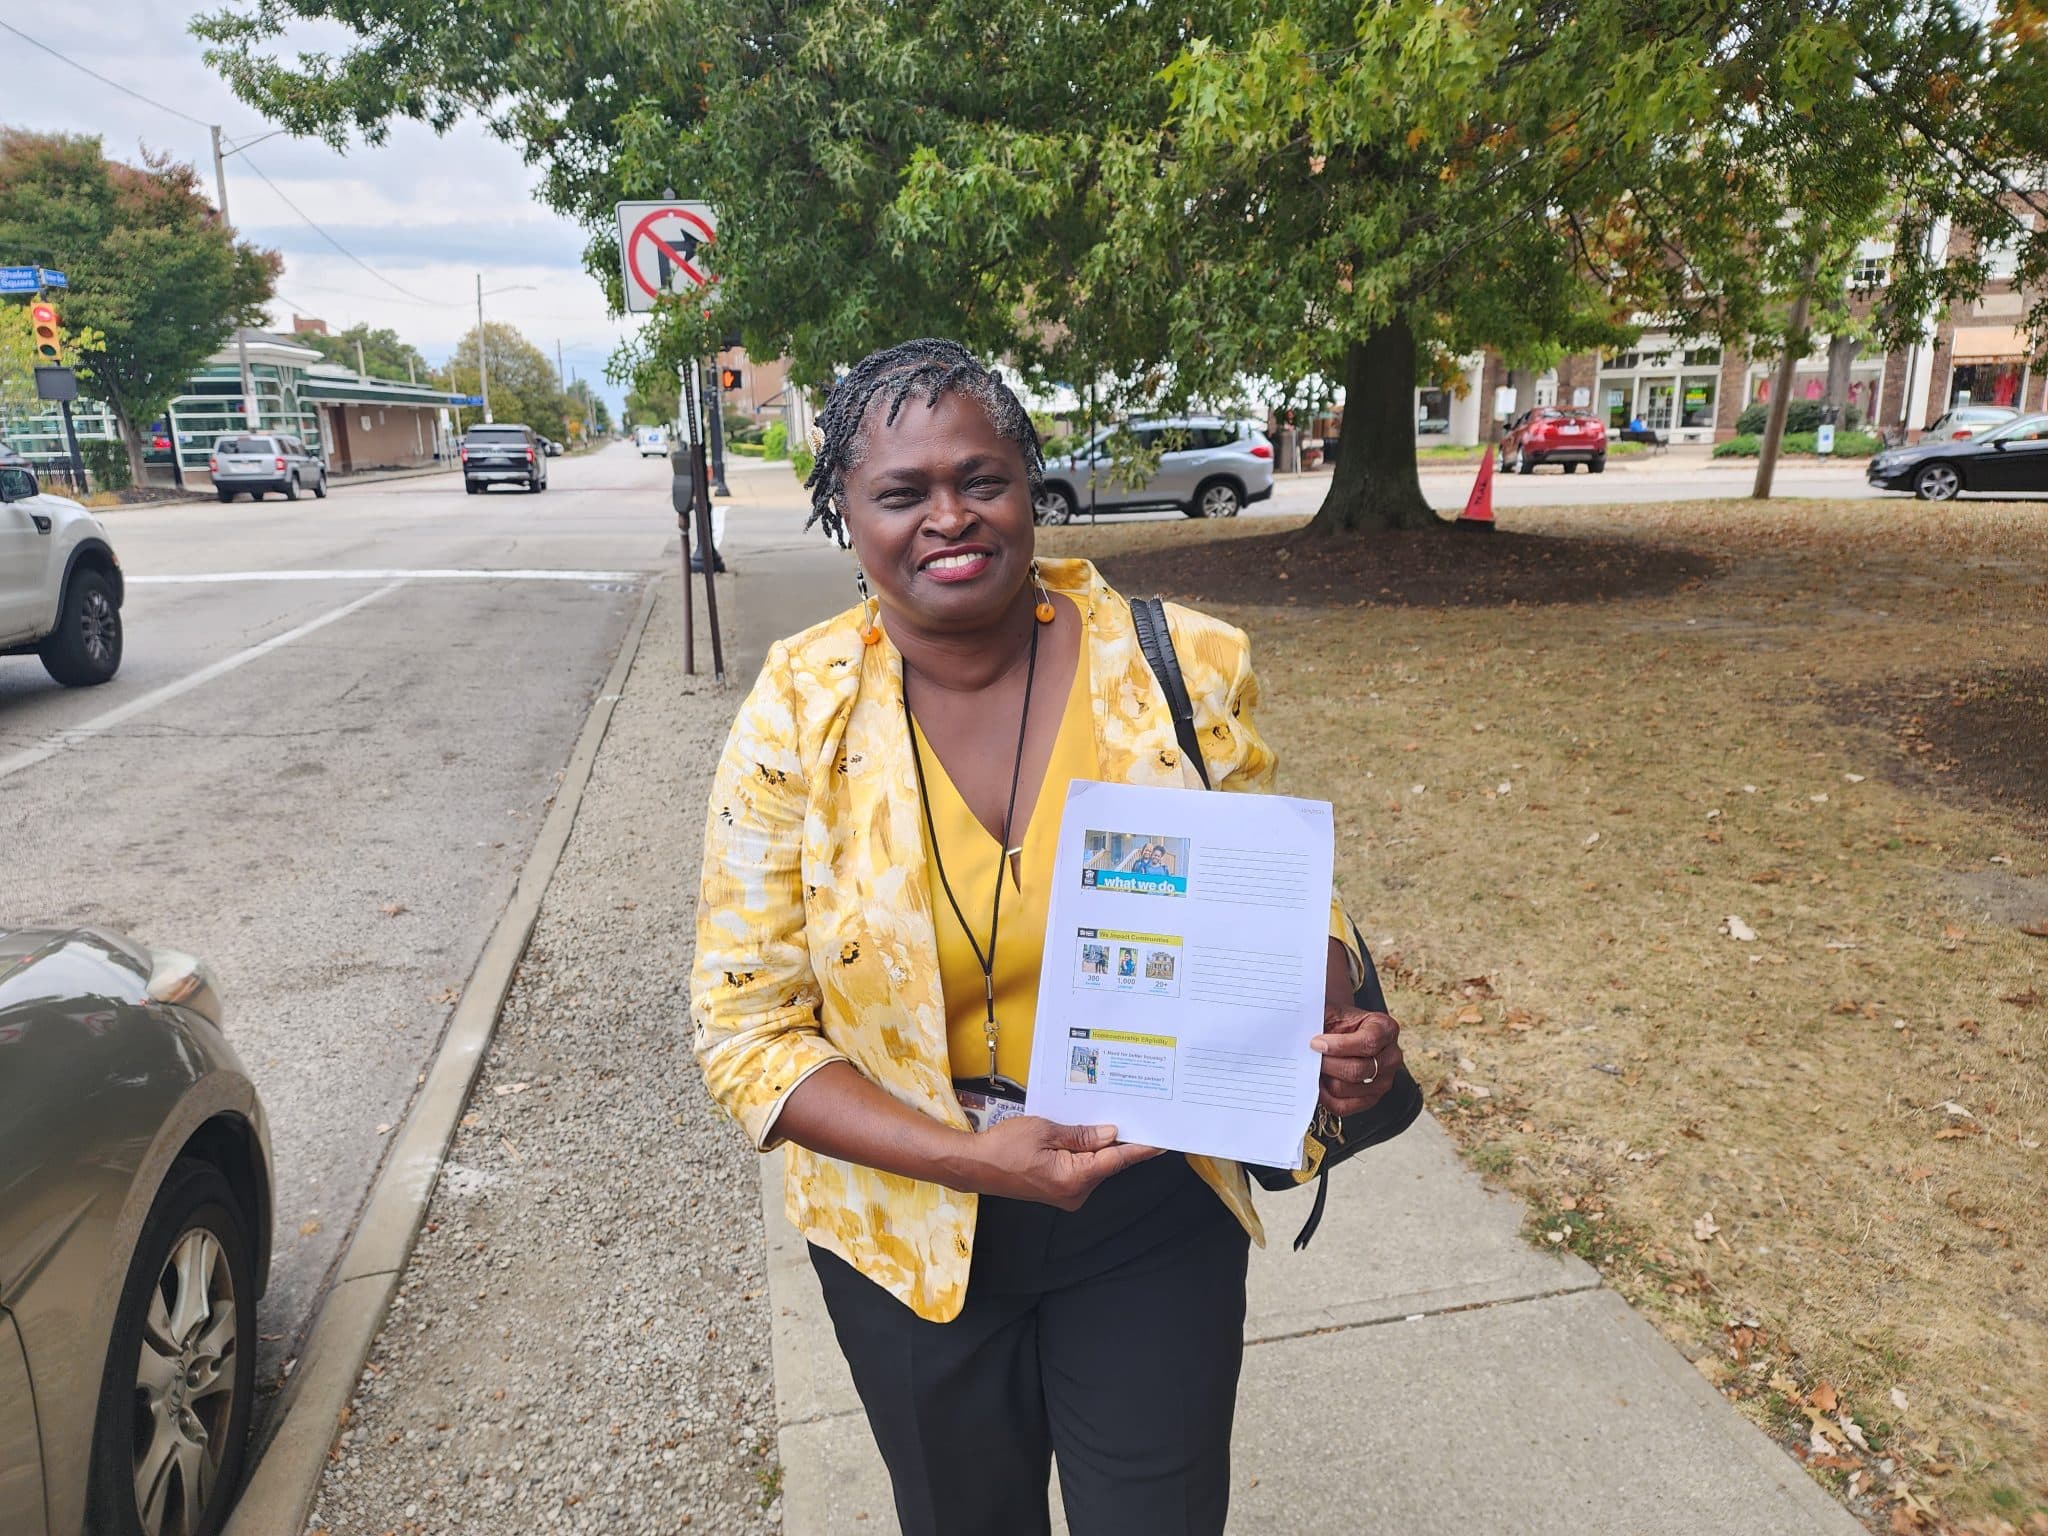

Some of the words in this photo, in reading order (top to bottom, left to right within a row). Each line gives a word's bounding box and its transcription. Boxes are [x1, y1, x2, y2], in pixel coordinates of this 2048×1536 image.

[0, 269, 32, 280] Shaker
[1, 279, 35, 289] Square
[1103, 876, 1136, 889] what
[1137, 880, 1157, 890] we
[1158, 880, 1176, 893] do
